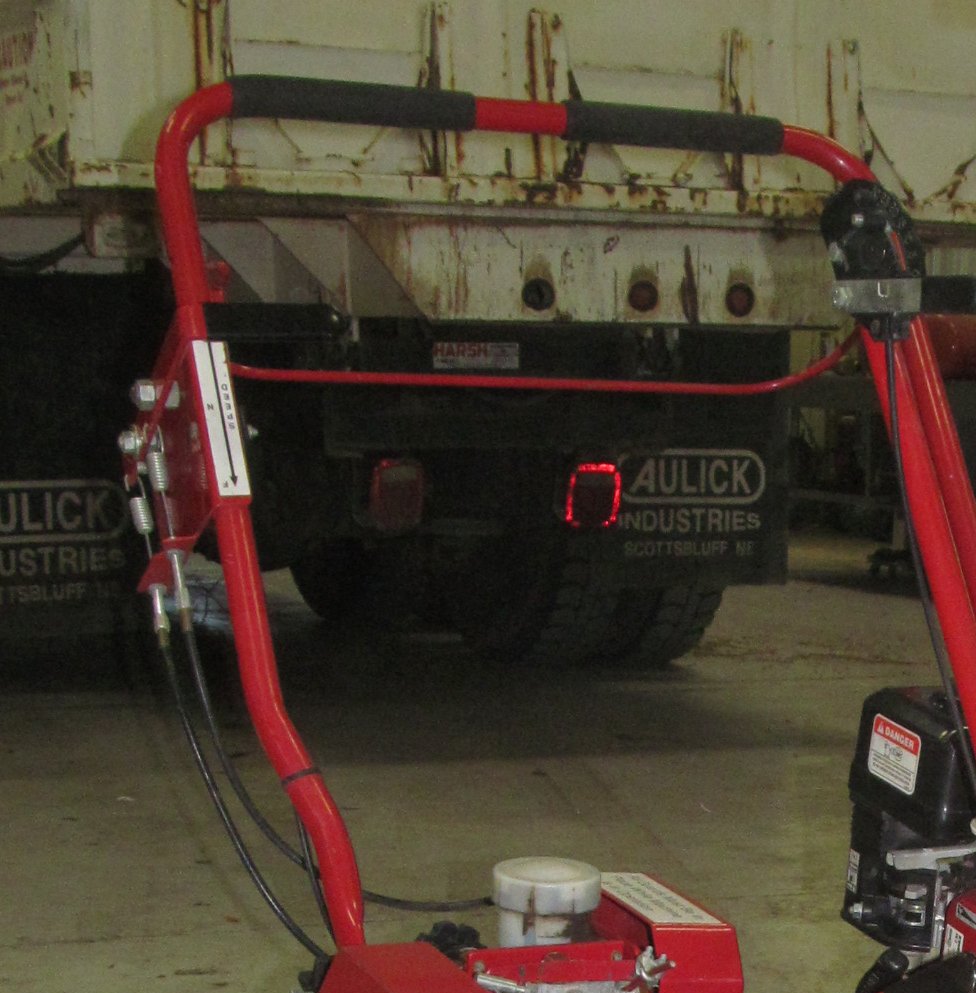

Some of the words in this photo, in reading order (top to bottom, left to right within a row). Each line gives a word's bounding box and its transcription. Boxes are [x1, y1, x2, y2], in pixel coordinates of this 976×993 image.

[432, 342, 489, 357] HARSH
[629, 459, 751, 494] AULICK
[617, 508, 761, 533] INDUSTRIES
[884, 726, 915, 750] DANGER
